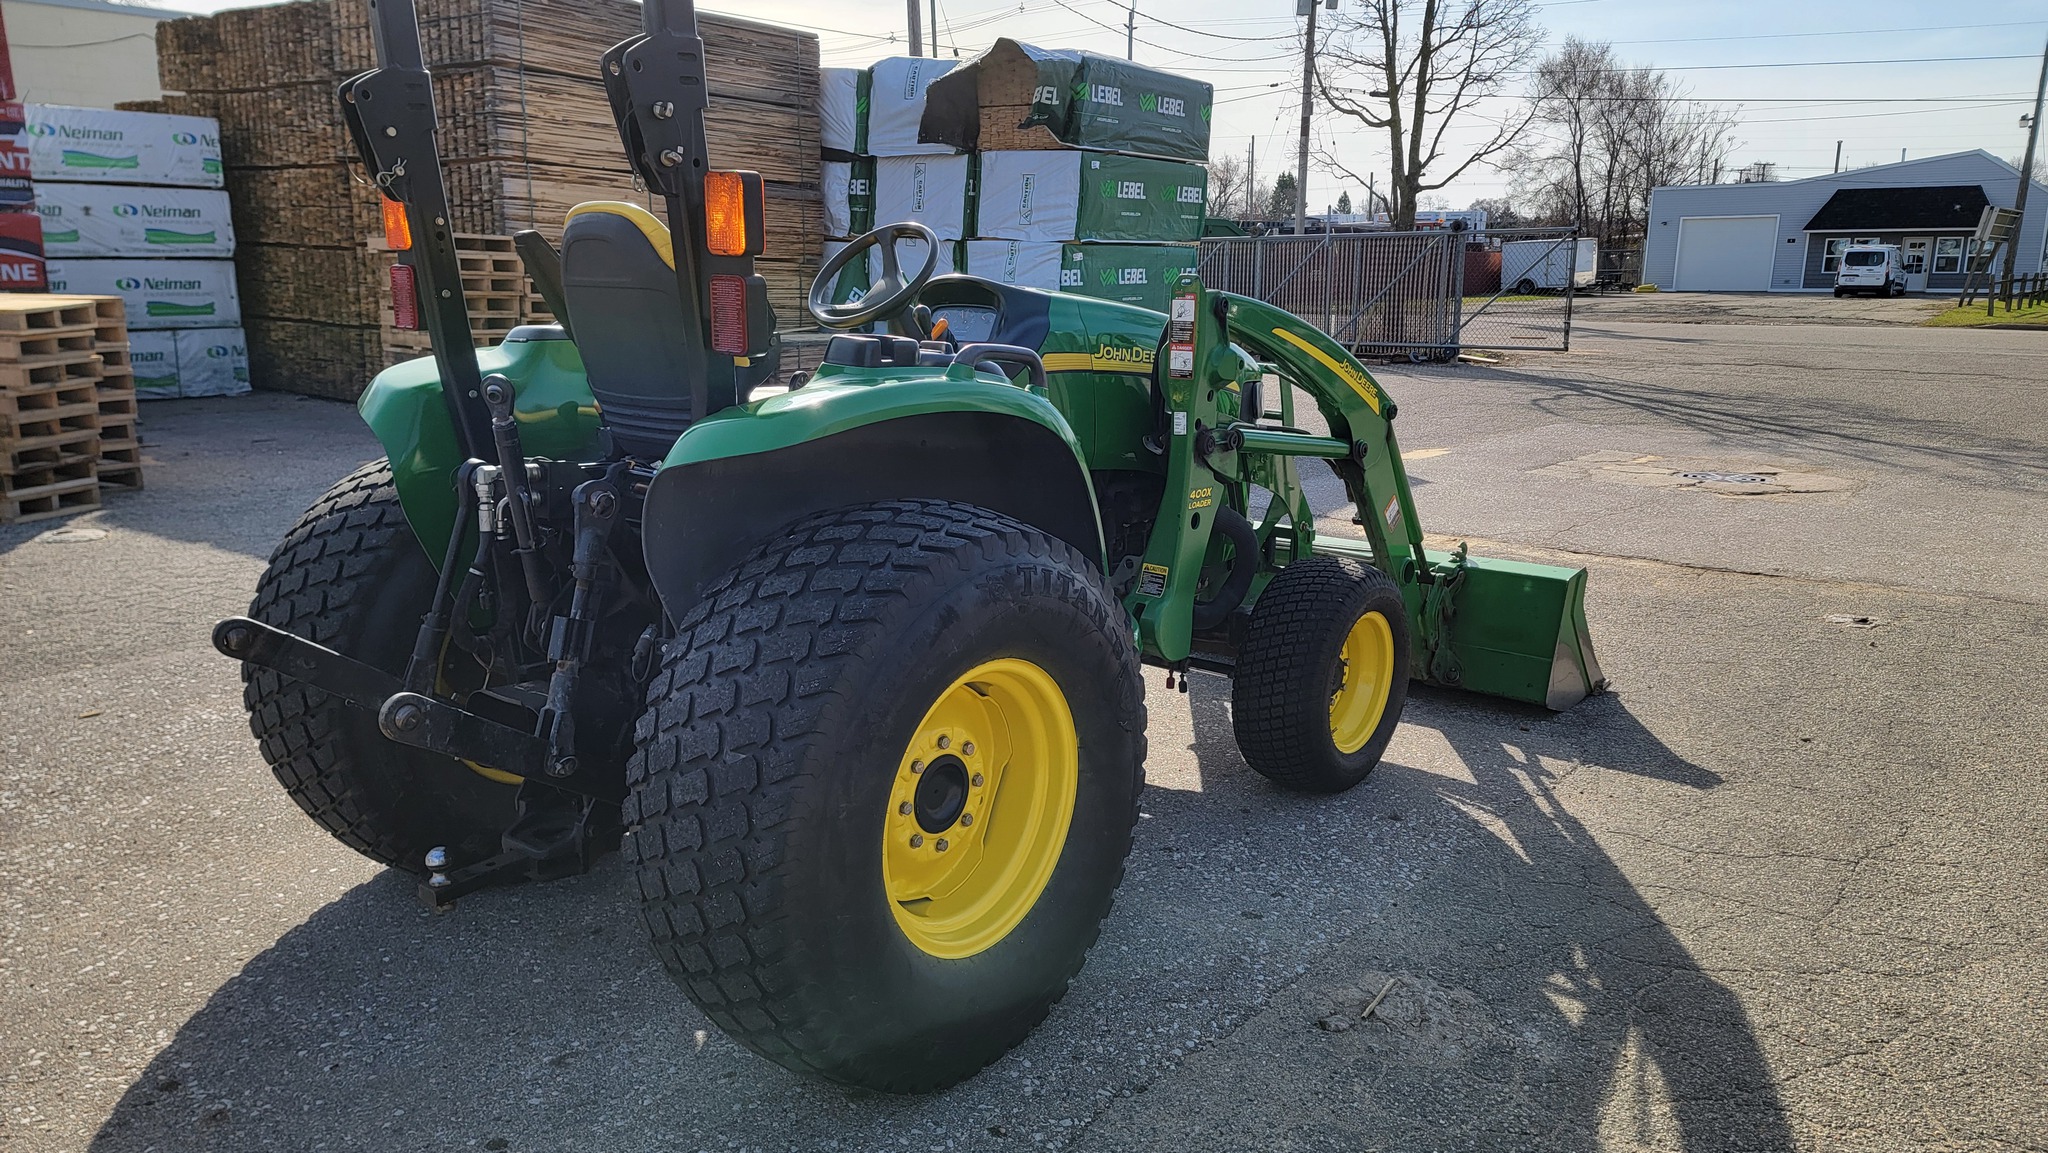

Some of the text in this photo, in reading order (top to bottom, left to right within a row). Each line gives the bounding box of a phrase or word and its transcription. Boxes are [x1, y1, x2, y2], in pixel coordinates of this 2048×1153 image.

[1033, 86, 1060, 106] BEL
[1091, 84, 1124, 107] LEBEL
[1157, 96, 1186, 118] LEBEL
[58, 125, 124, 141] Neiman
[849, 179, 870, 195] BEL
[1021, 176, 1030, 209] CAUTION
[1117, 181, 1147, 200] LEBEL
[1176, 186, 1203, 204] LEBEL
[141, 204, 201, 218] Neiman
[1007, 241, 1016, 266] CAUTI
[143, 277, 201, 290] Neiman
[1060, 269, 1084, 286] BEL
[1118, 268, 1148, 285] LEBEL
[130, 351, 164, 362] man
[1094, 343, 1156, 363] JOHN DEE
[1339, 358, 1378, 399] JOHN DEERE
[1189, 487, 1213, 500] 400X
[1188, 498, 1212, 510] LOADER
[1149, 564, 1168, 575] CAUTION
[1016, 564, 1110, 632] TITAN
